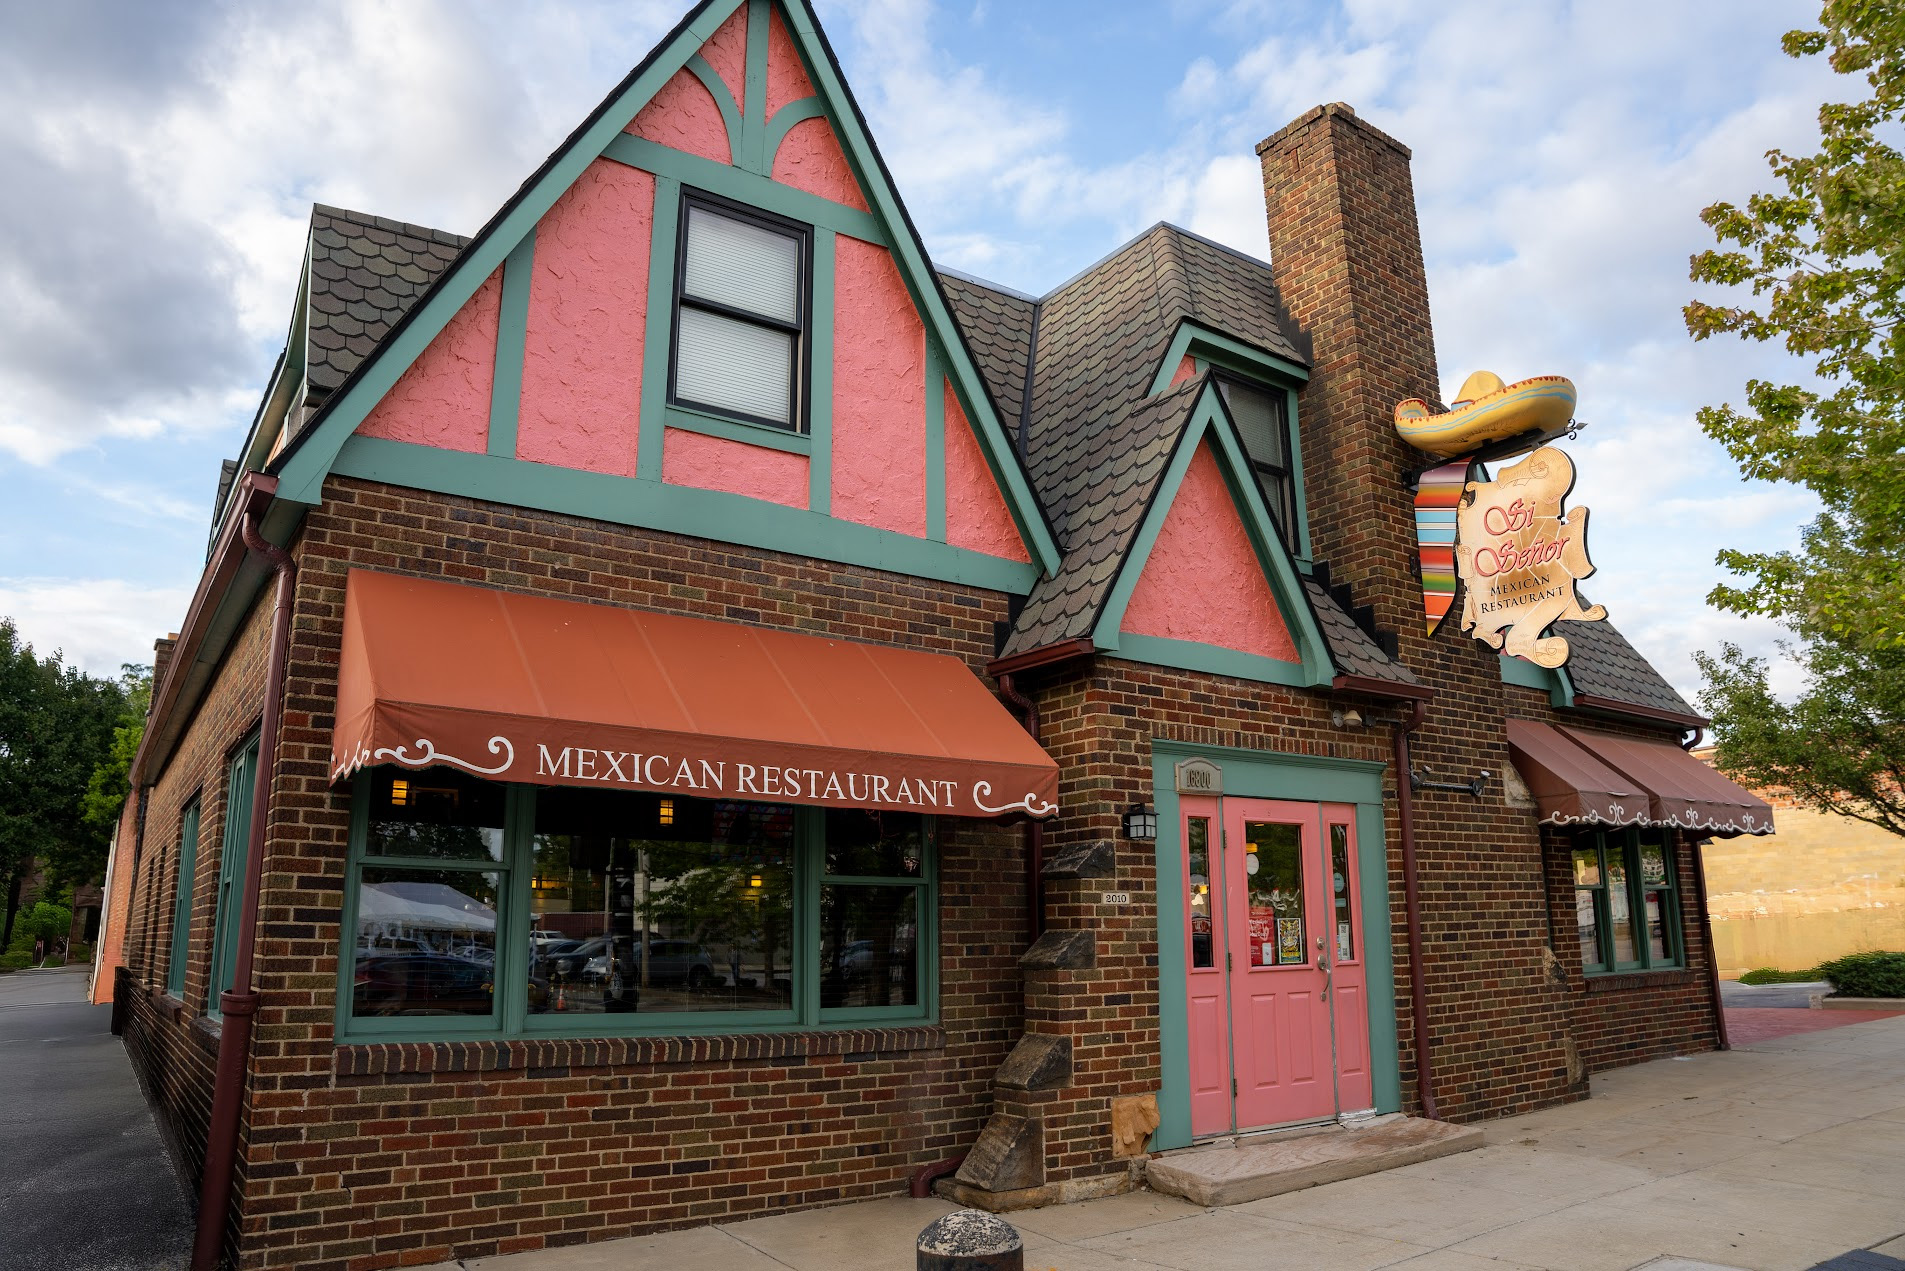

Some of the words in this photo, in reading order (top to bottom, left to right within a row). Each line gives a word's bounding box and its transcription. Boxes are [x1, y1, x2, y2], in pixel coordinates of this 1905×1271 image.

[1483, 498, 1536, 536] Si
[1474, 537, 1570, 577] Señor
[1490, 574, 1551, 596] MEXICAN
[1481, 586, 1564, 613] RESTAURANT
[536, 743, 726, 790] MEXICAN
[736, 763, 958, 807] RESTAURANT
[1186, 769, 1212, 789] 16800
[1105, 894, 1127, 903] 2010
